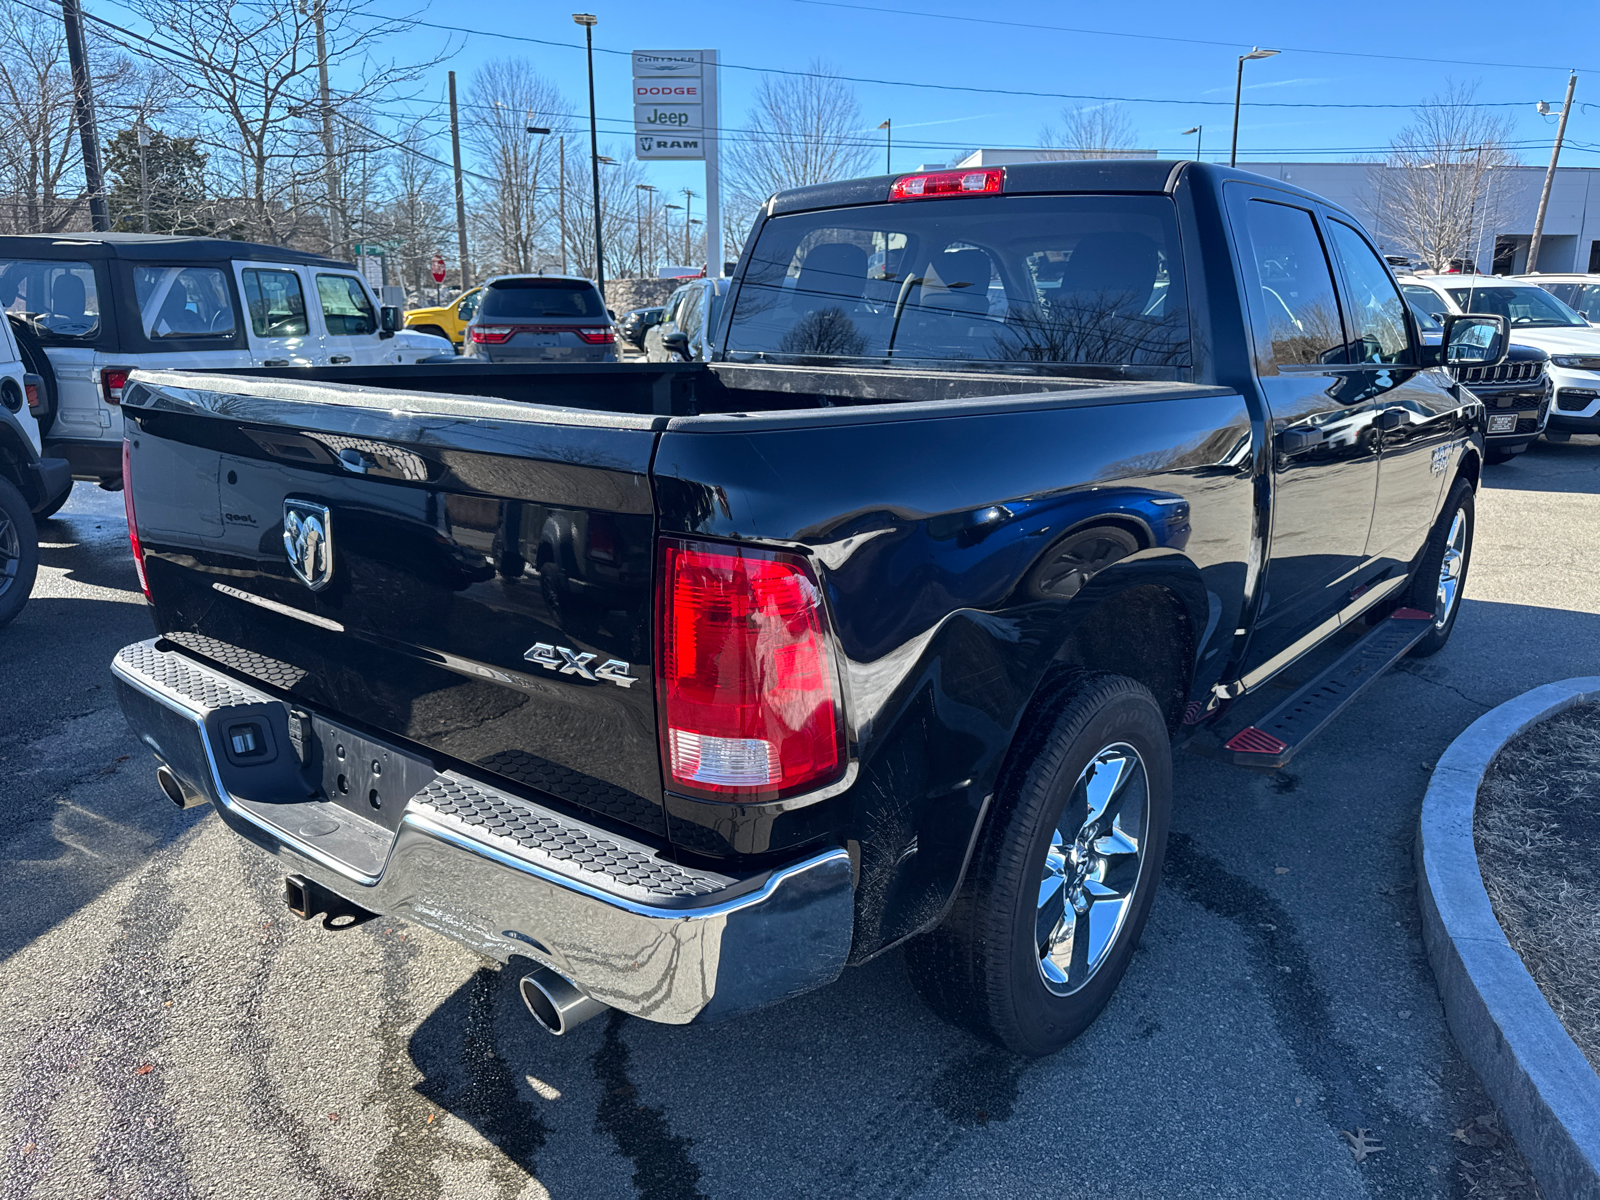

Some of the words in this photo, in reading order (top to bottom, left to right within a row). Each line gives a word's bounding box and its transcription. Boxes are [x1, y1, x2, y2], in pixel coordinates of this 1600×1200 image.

[637, 87, 697, 95] DODGE
[647, 109, 689, 127] Jeep
[656, 141, 698, 149] RAM
